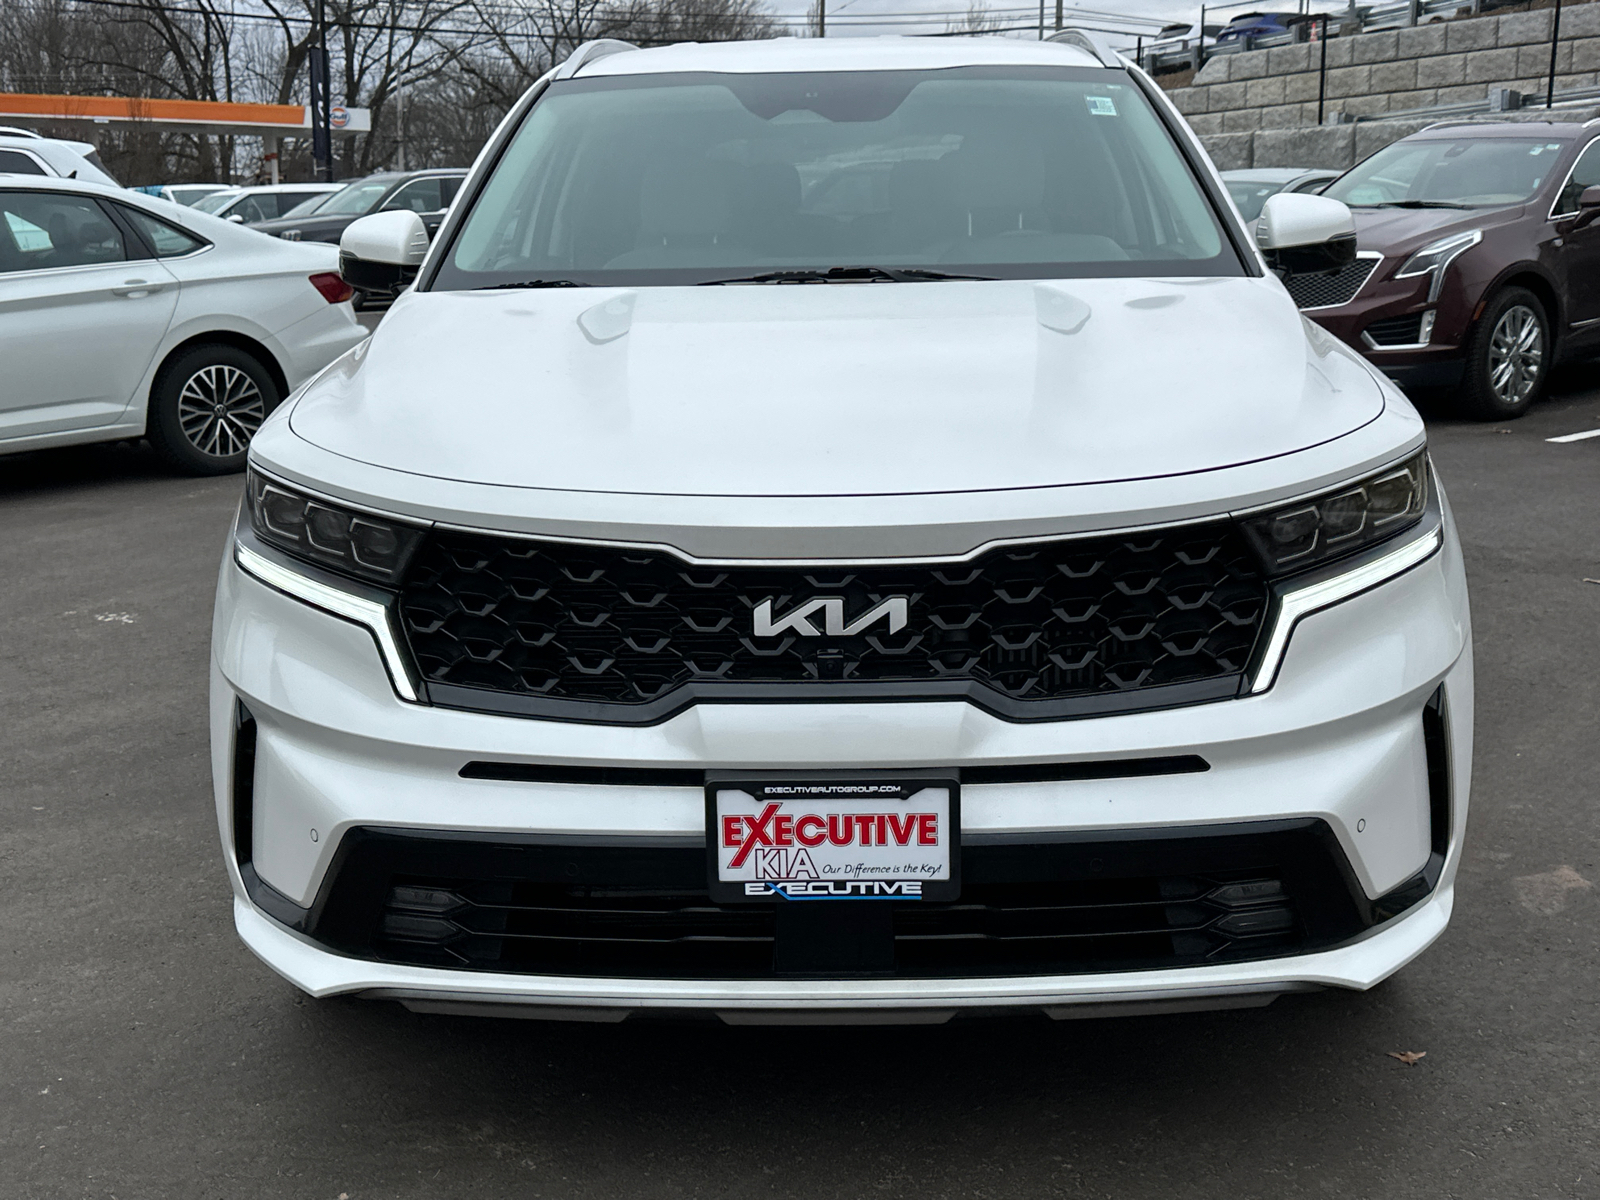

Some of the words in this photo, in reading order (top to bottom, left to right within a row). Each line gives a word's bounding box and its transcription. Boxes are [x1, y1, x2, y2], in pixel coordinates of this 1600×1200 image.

[722, 802, 939, 869] EXECUTIVE
[755, 848, 820, 879] KIA
[822, 864, 841, 874] Our
[844, 863, 891, 878] Difference
[892, 864, 900, 873] is
[903, 863, 918, 873] the
[920, 863, 942, 878] Key!
[745, 881, 922, 899] EXECUTIVE
